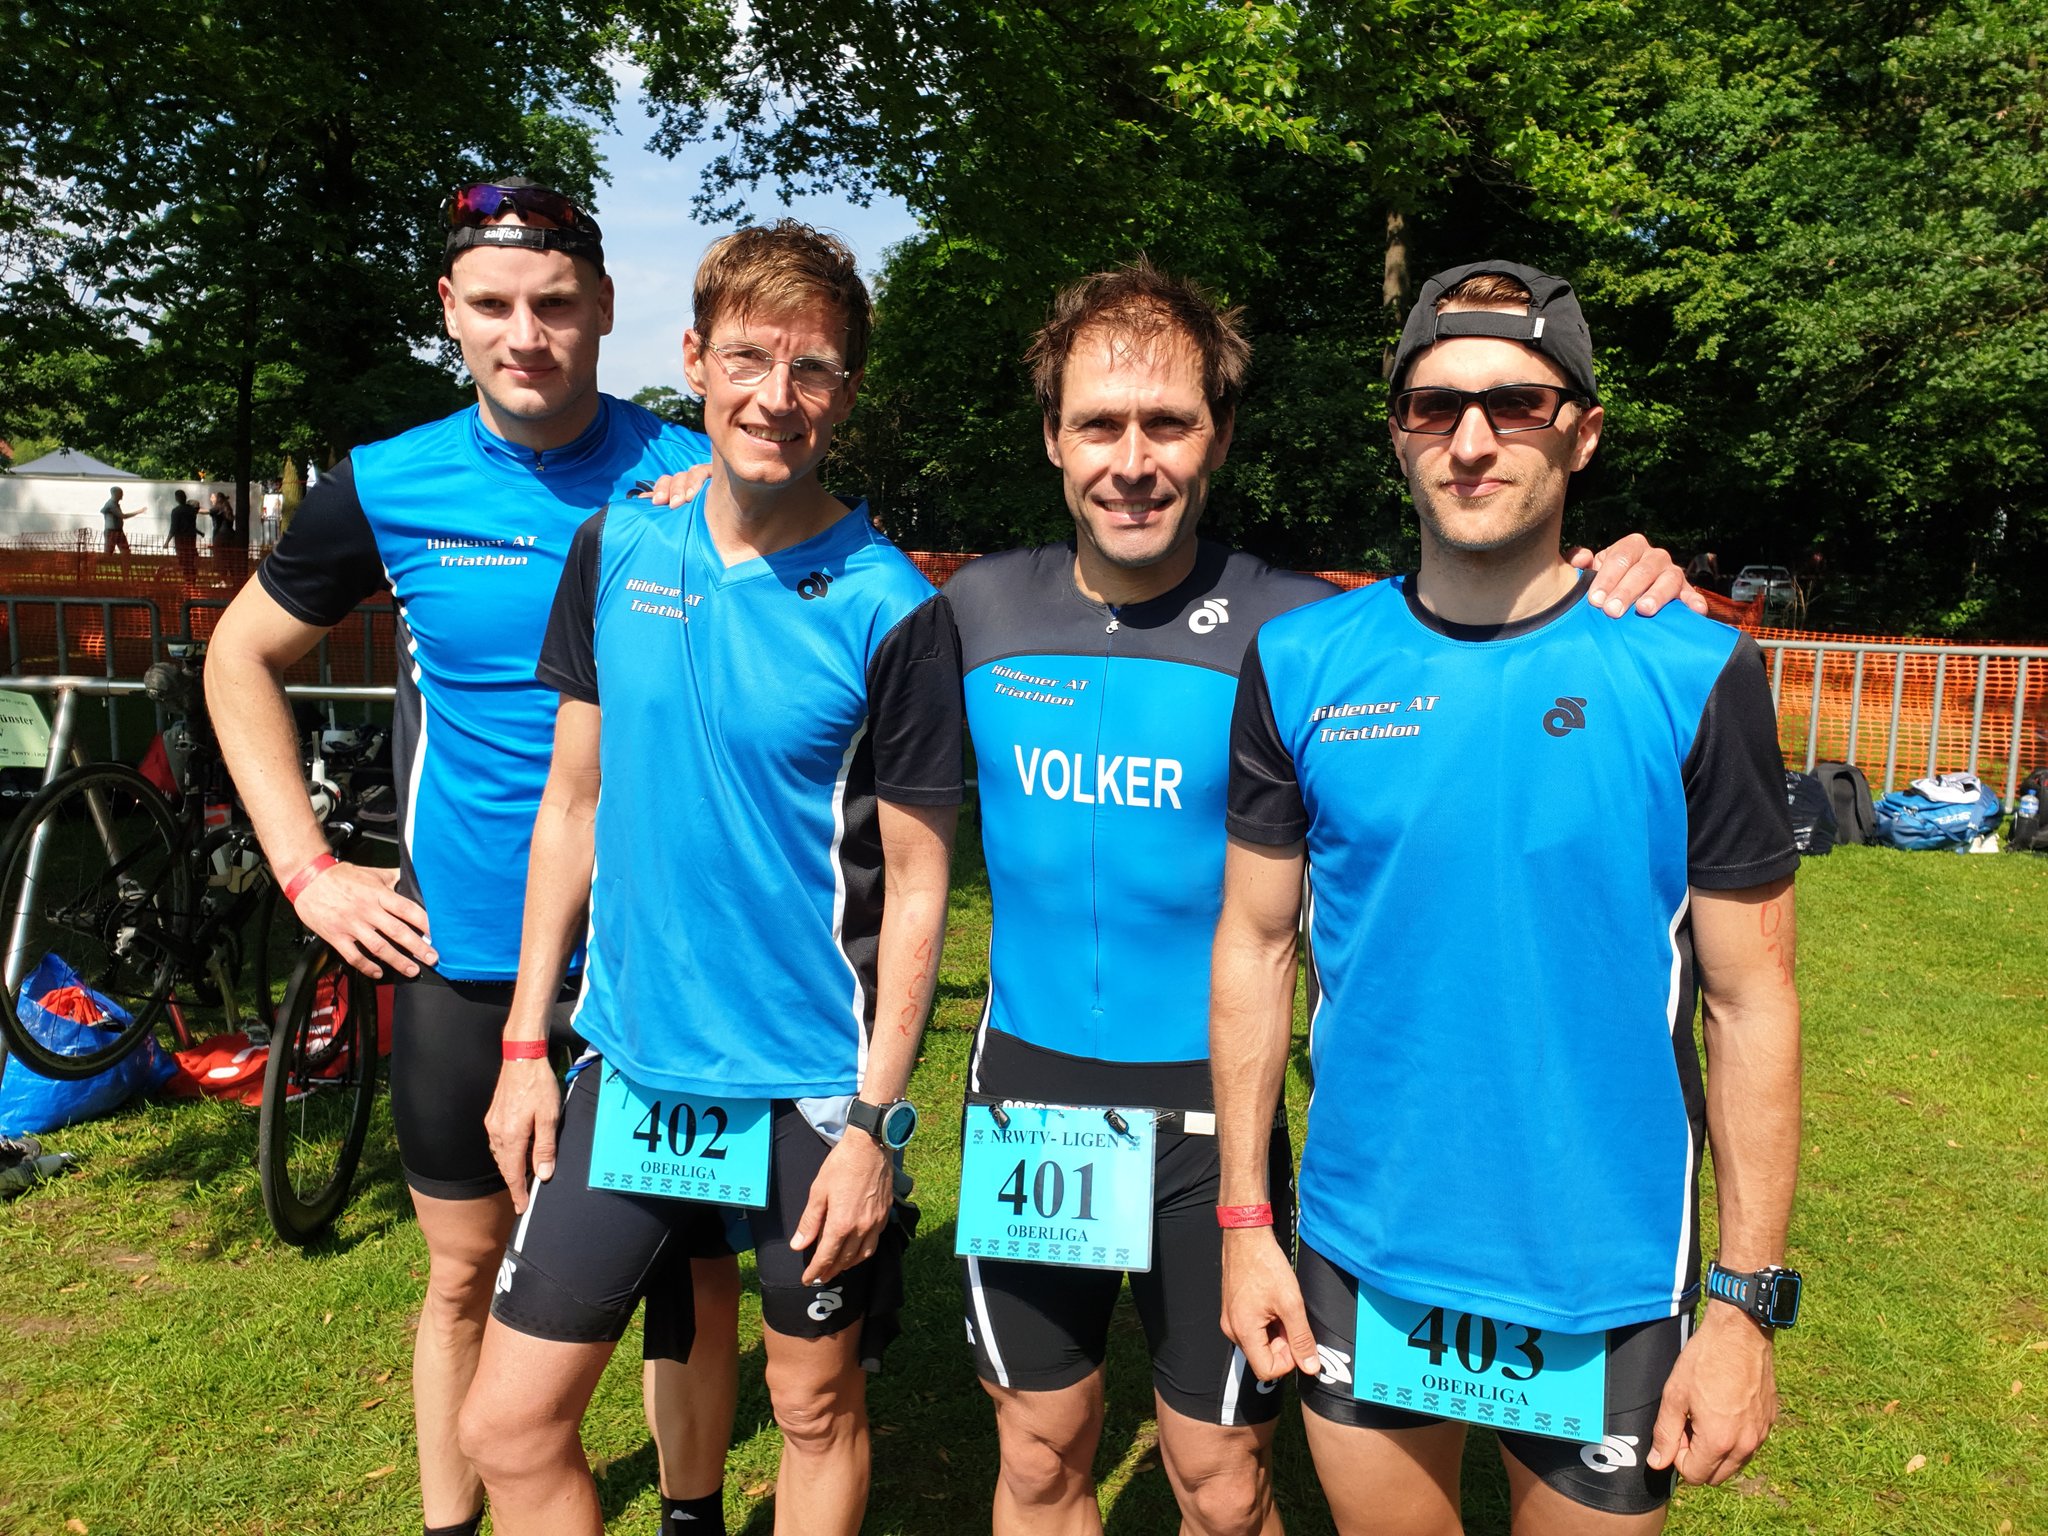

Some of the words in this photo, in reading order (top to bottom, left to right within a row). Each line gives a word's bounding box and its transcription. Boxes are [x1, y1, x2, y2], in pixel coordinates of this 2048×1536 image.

[484, 227, 523, 241] sailfish
[427, 536, 506, 550] Hildener
[512, 535, 538, 549] AT
[439, 553, 529, 568] Triathlon
[684, 594, 704, 607] AT
[990, 664, 1060, 688] Hildener
[1063, 678, 1090, 691] AT
[994, 682, 1075, 707] Triathlon
[1308, 700, 1401, 723] Hildener
[1405, 696, 1440, 713] AT
[1319, 723, 1420, 743] Triathlon
[1014, 744, 1183, 810] VOLKER
[632, 1100, 729, 1161] 402
[1063, 1131, 1119, 1148] LIGEN
[640, 1160, 716, 1180] OBERLIGA
[997, 1158, 1099, 1221] 401
[1007, 1224, 1088, 1242] OBERLIGA
[1407, 1307, 1545, 1382] 403
[1421, 1374, 1529, 1406] OBERLIGA
